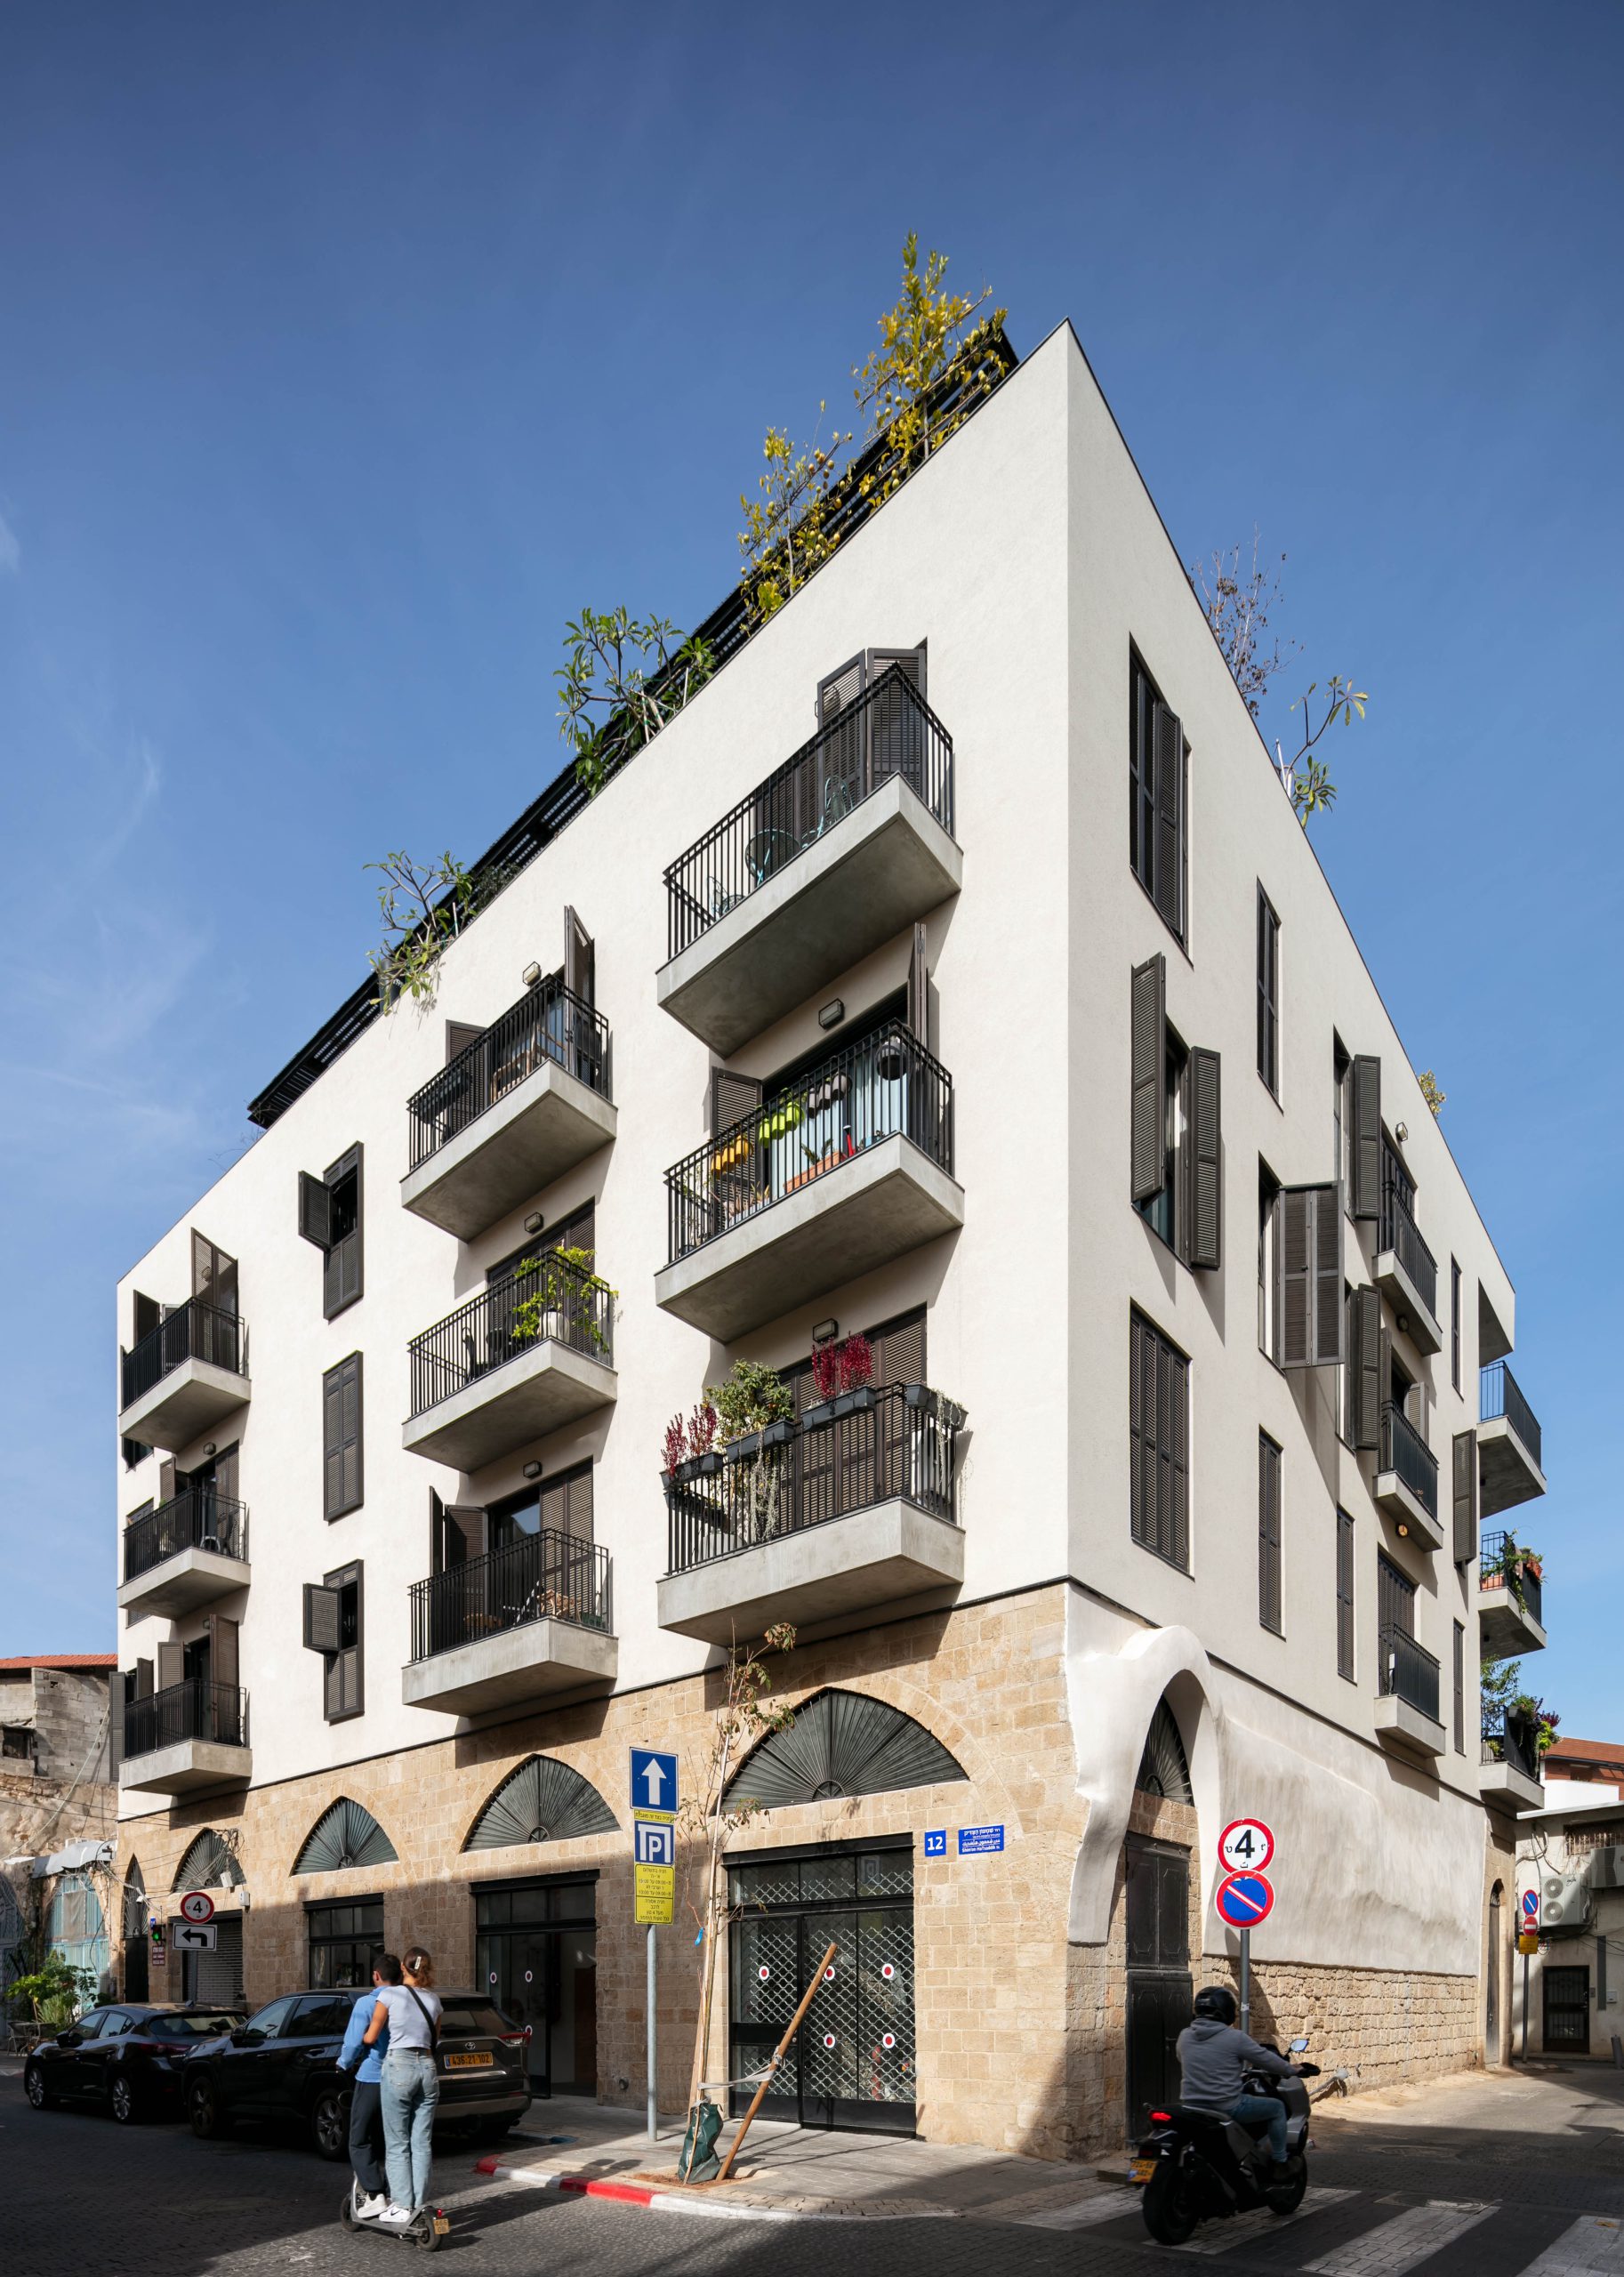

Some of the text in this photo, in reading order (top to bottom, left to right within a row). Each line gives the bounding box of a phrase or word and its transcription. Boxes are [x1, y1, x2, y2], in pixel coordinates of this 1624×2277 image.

[649, 1835, 662, 1861] P
[928, 1836, 943, 1851] 12
[1235, 1829, 1255, 1859] 4
[193, 1900, 202, 1914] 4
